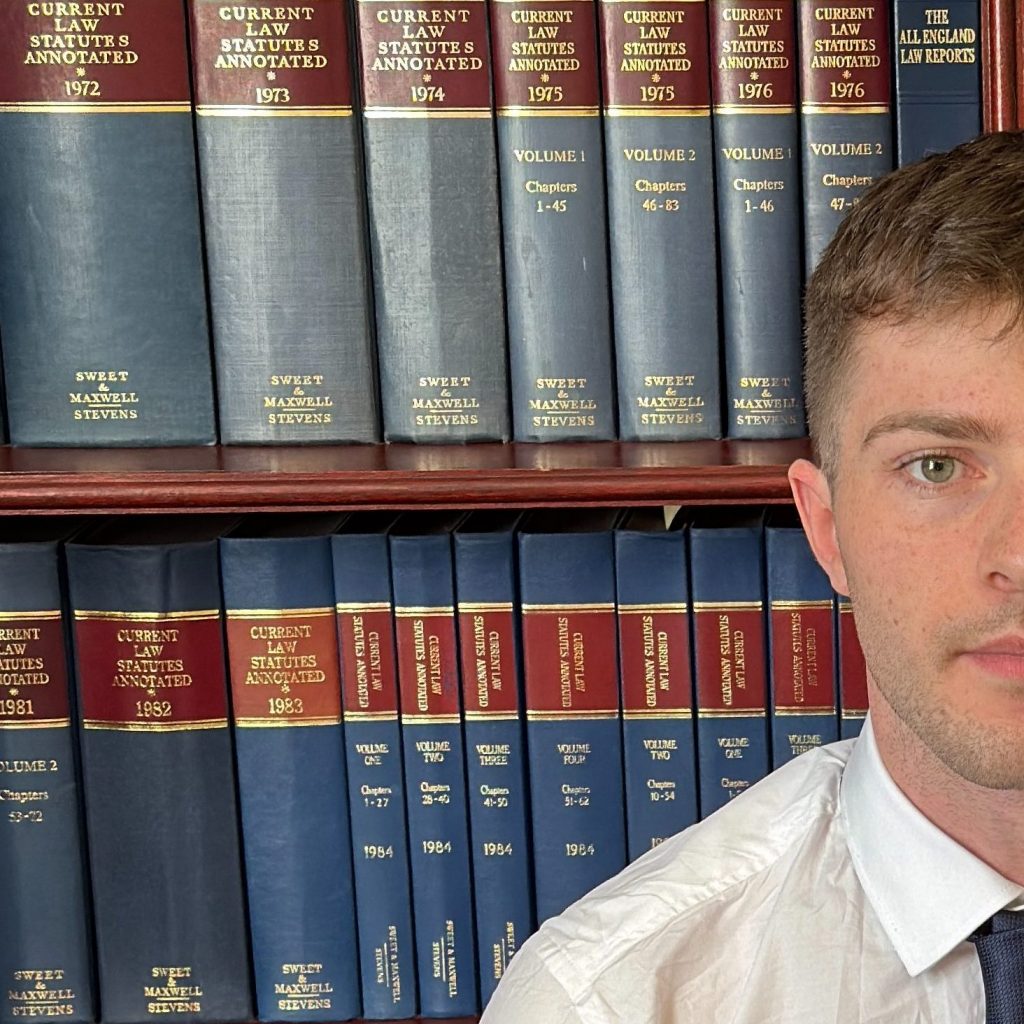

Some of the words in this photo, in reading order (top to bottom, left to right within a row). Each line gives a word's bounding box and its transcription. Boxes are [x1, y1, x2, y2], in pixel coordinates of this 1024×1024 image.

[27, 2, 124, 17] CURRENT
[218, 5, 314, 21] CURRENT
[722, 8, 782, 22] CURRENT
[815, 7, 874, 21] CURRENT
[925, 9, 949, 24] THE
[376, 9, 470, 25] CURRENT
[511, 10, 573, 24] CURRENT
[623, 10, 684, 24] CURRENT
[54, 18, 99, 32] LAW
[245, 22, 289, 37] LAW
[402, 24, 445, 39] LAW
[738, 24, 769, 37] LAW
[831, 23, 861, 36] LAW
[528, 26, 559, 39] LAW
[639, 26, 670, 39] LAW
[899, 29, 921, 44] ALL
[922, 28, 976, 44] ENGLAND
[30, 34, 129, 48] STATUTES
[219, 37, 319, 53] STATUTES
[378, 41, 474, 54] STATUTES
[722, 40, 784, 53] STATUTES
[815, 39, 876, 52] STATUTES
[512, 42, 575, 55] STATUTES
[623, 41, 686, 56] STATUTES
[24, 49, 138, 65] ANNOTATED
[213, 53, 327, 69] ANNOTATED
[718, 55, 788, 70] ANNOTATED
[811, 54, 880, 68] ANNOTATED
[900, 49, 923, 64] LAW
[925, 48, 975, 63] REPORTS
[371, 57, 482, 71] ANNOTATED
[508, 58, 580, 72] ANNOTATED
[620, 58, 691, 72] ANNOTATED
[64, 80, 100, 96] 1972
[410, 86, 445, 103] 1974
[528, 86, 563, 102] 1975
[640, 86, 675, 102] 1975
[738, 83, 773, 99] 1976
[830, 82, 865, 98] 1976
[255, 87, 290, 104] 1973
[514, 150, 576, 163] VOLUME
[581, 150, 585, 162] 1
[623, 147, 685, 162] VOLUME
[688, 149, 696, 161] 2
[721, 148, 784, 161] VOLUME
[811, 143, 872, 156] VOLUME
[875, 143, 882, 154] 2
[525, 180, 577, 195] Chapters
[634, 179, 686, 194] Chapters
[733, 178, 784, 192] Chapters
[822, 173, 872, 188] Chapters
[76, 371, 128, 381] SWEET
[537, 378, 586, 390] SWEET
[69, 393, 139, 403] MAXWELL
[529, 398, 596, 410] MAXWELL
[74, 409, 138, 420] STEVENS
[532, 416, 594, 427] STEVENS
[117, 629, 179, 642] CURRENT
[250, 625, 311, 639] CURRENT
[134, 645, 163, 657] LAW
[267, 641, 297, 654] LAW
[117, 659, 184, 673] STATUTES
[251, 655, 317, 669] STATUTES
[113, 674, 192, 688] ANNOTATED
[245, 670, 325, 685] ANNOTATED
[136, 701, 172, 717] 1982
[268, 698, 303, 714] 1983
[416, 741, 451, 752] VOLUME
[423, 752, 444, 763] TWO
[479, 755, 508, 765] THREE
[423, 841, 451, 854] 1984
[144, 986, 203, 997] MAXWELL
[148, 1002, 201, 1013] STEVENS
